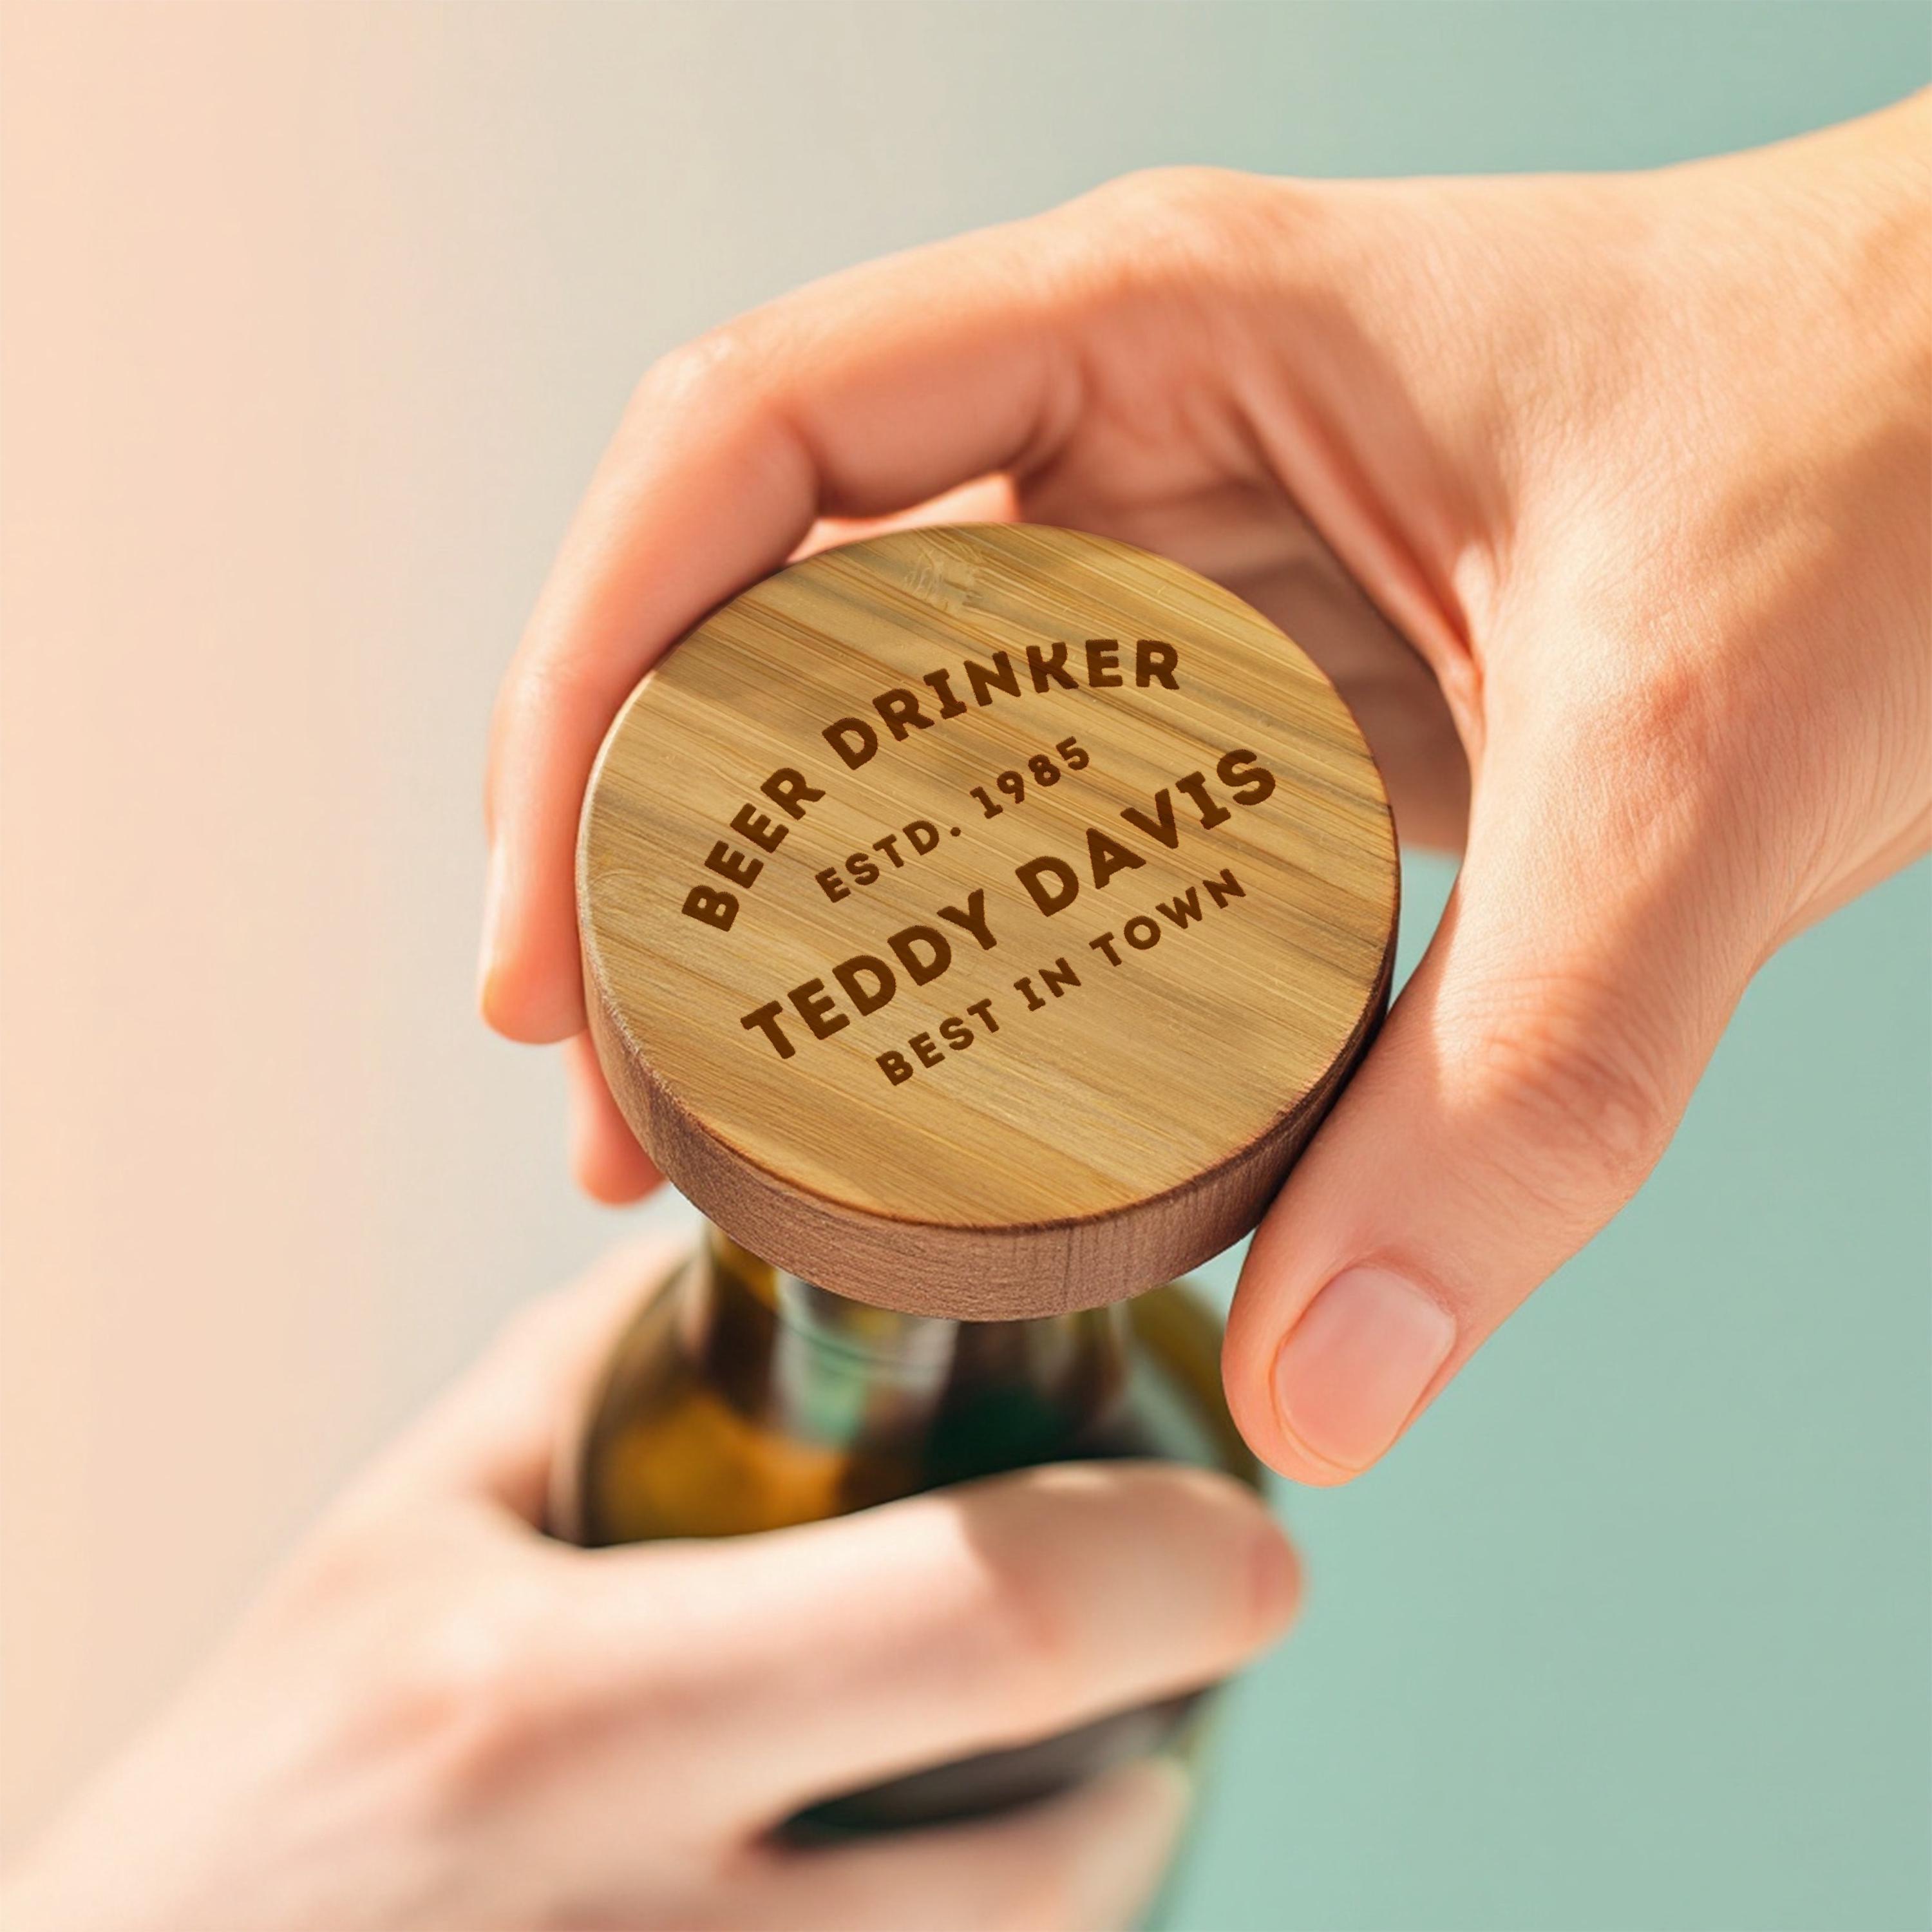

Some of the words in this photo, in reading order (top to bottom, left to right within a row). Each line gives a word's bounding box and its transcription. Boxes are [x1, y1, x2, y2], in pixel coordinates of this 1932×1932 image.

[681, 768, 826, 932] BEER
[821, 639, 1180, 770] DRINKER
[740, 888, 998, 1059] TEDDY
[1015, 748, 1276, 918] DAVIS
[815, 820, 962, 904] ESTD.
[969, 735, 1089, 819] 1985
[875, 998, 999, 1086] BEST
[1013, 957, 1081, 1012] IN
[1088, 868, 1246, 967] TOWN
